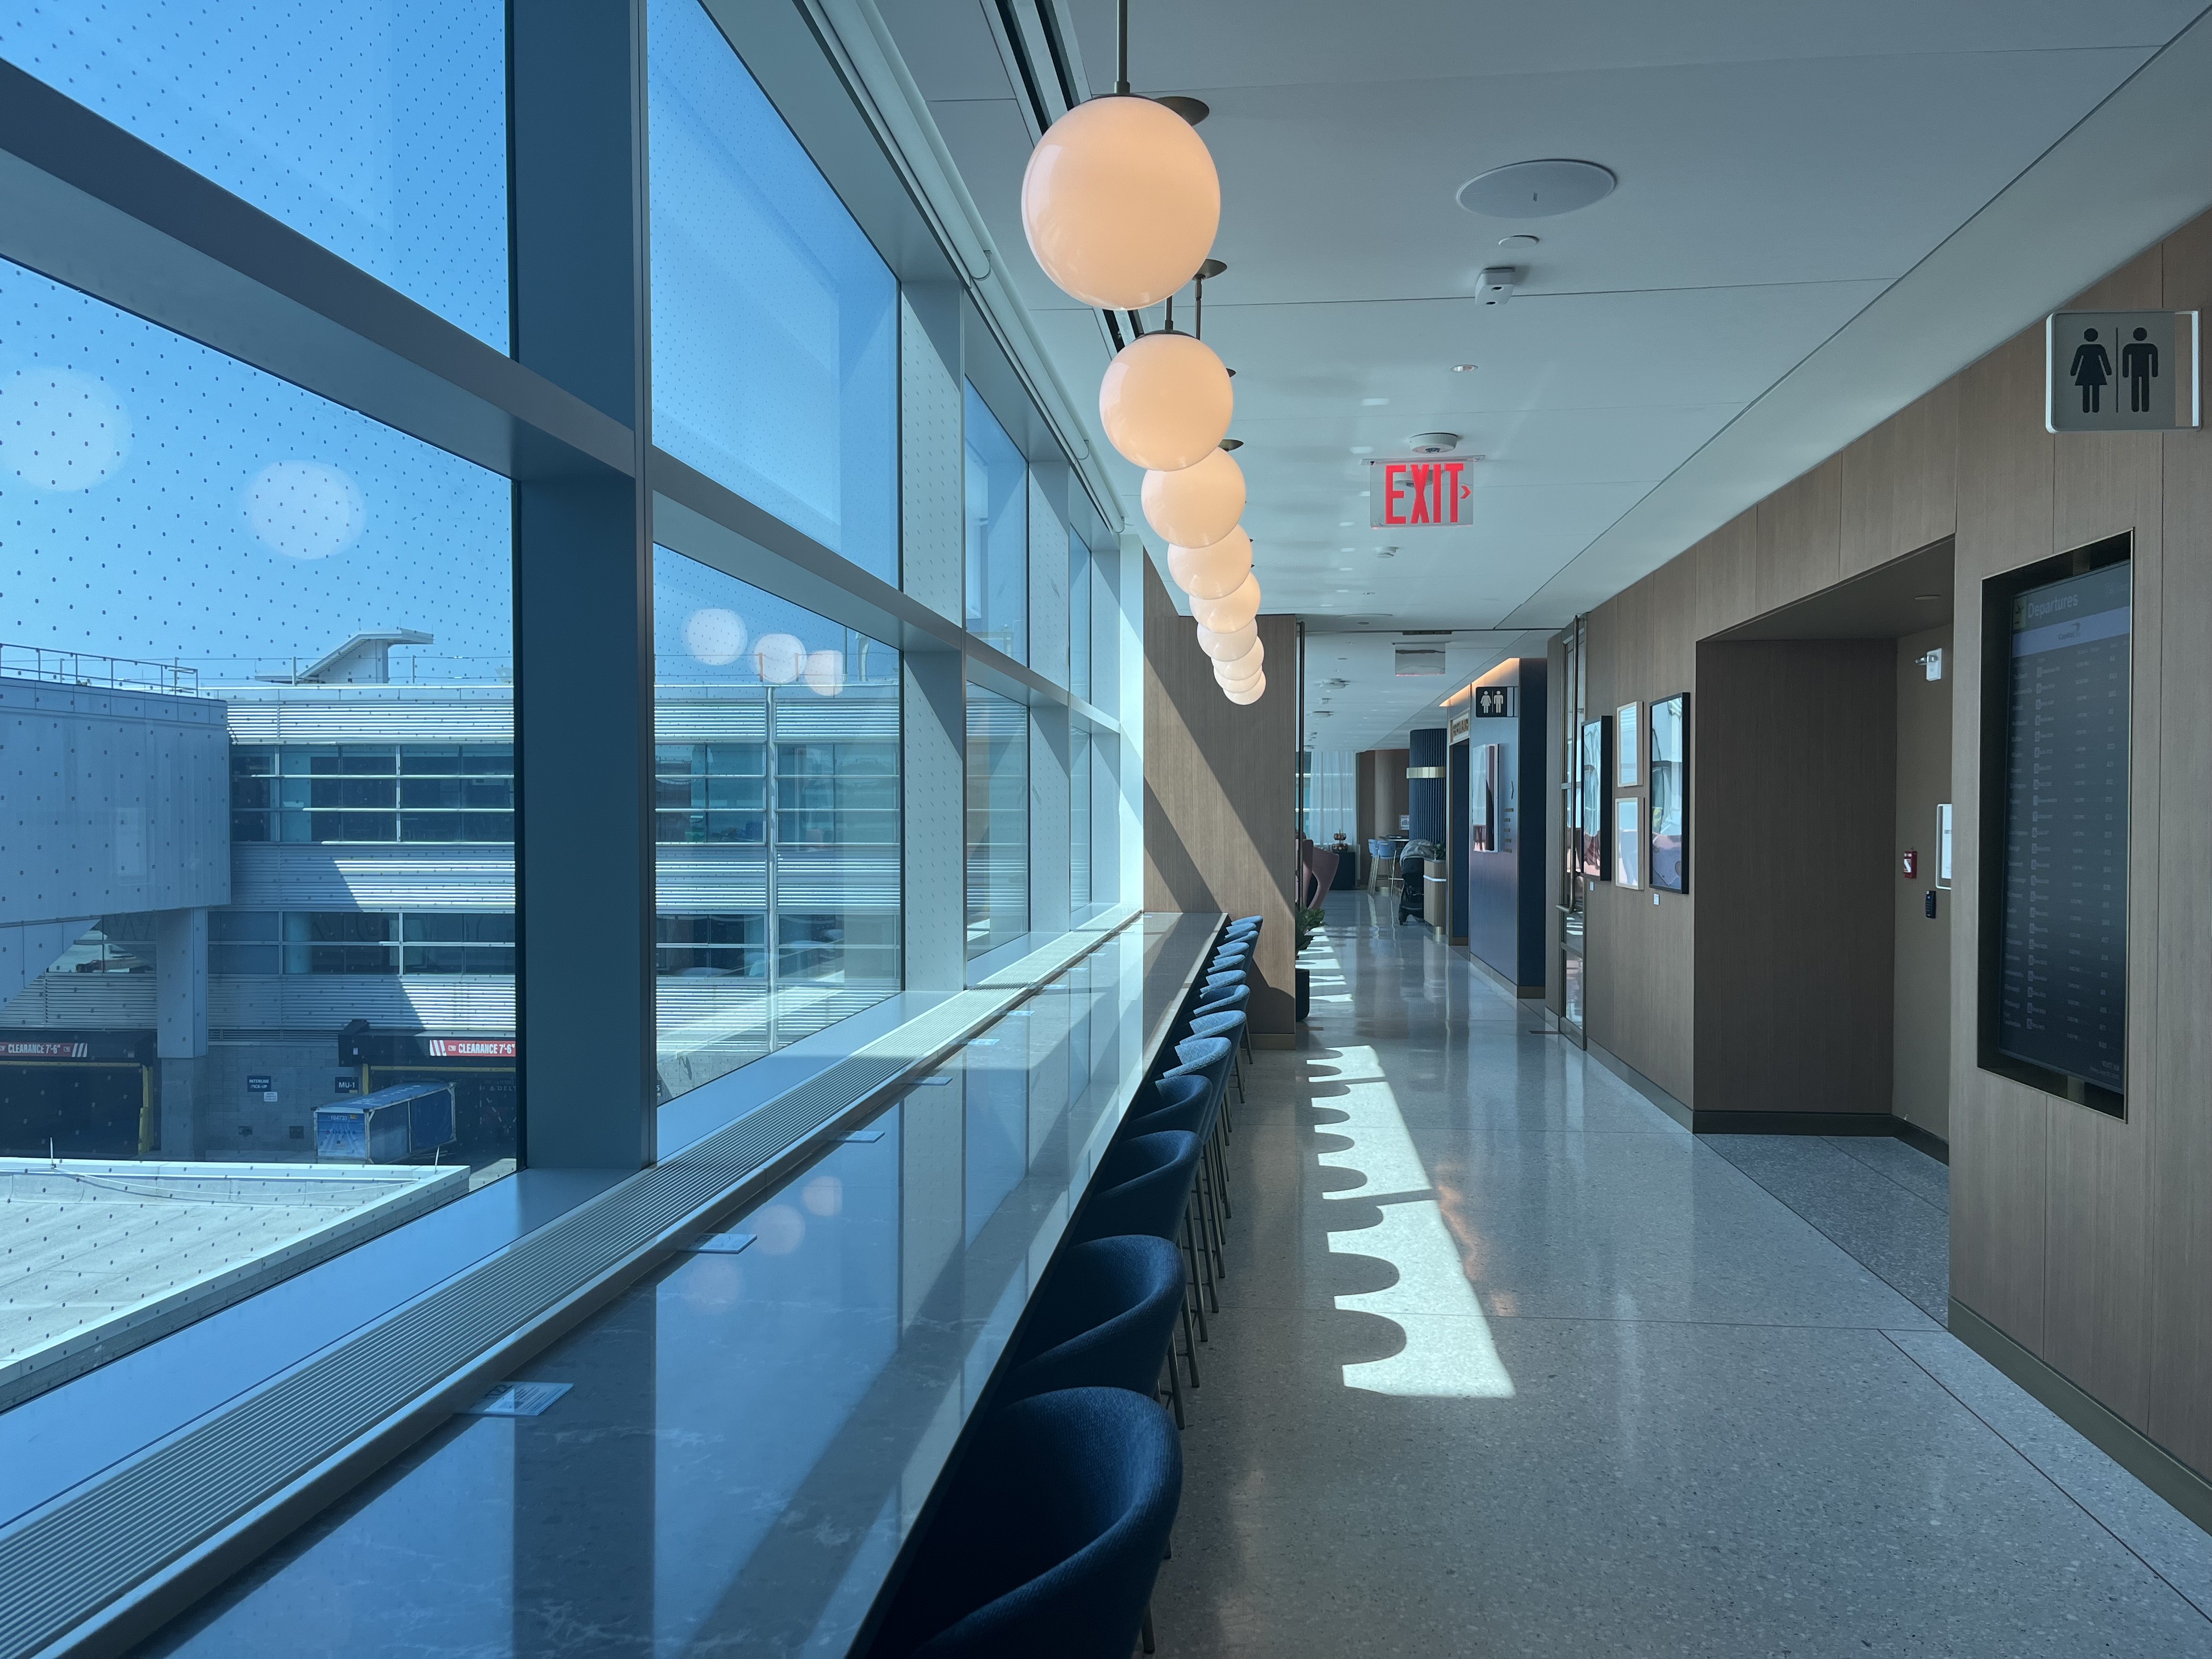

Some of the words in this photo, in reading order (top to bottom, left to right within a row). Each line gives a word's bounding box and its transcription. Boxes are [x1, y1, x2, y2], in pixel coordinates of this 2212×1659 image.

[1385, 462, 1465, 524] EXIT
[2027, 594, 2078, 619] Departures
[8, 1043, 44, 1054] CLEARANCE
[458, 1043, 498, 1054] CLEARANCE
